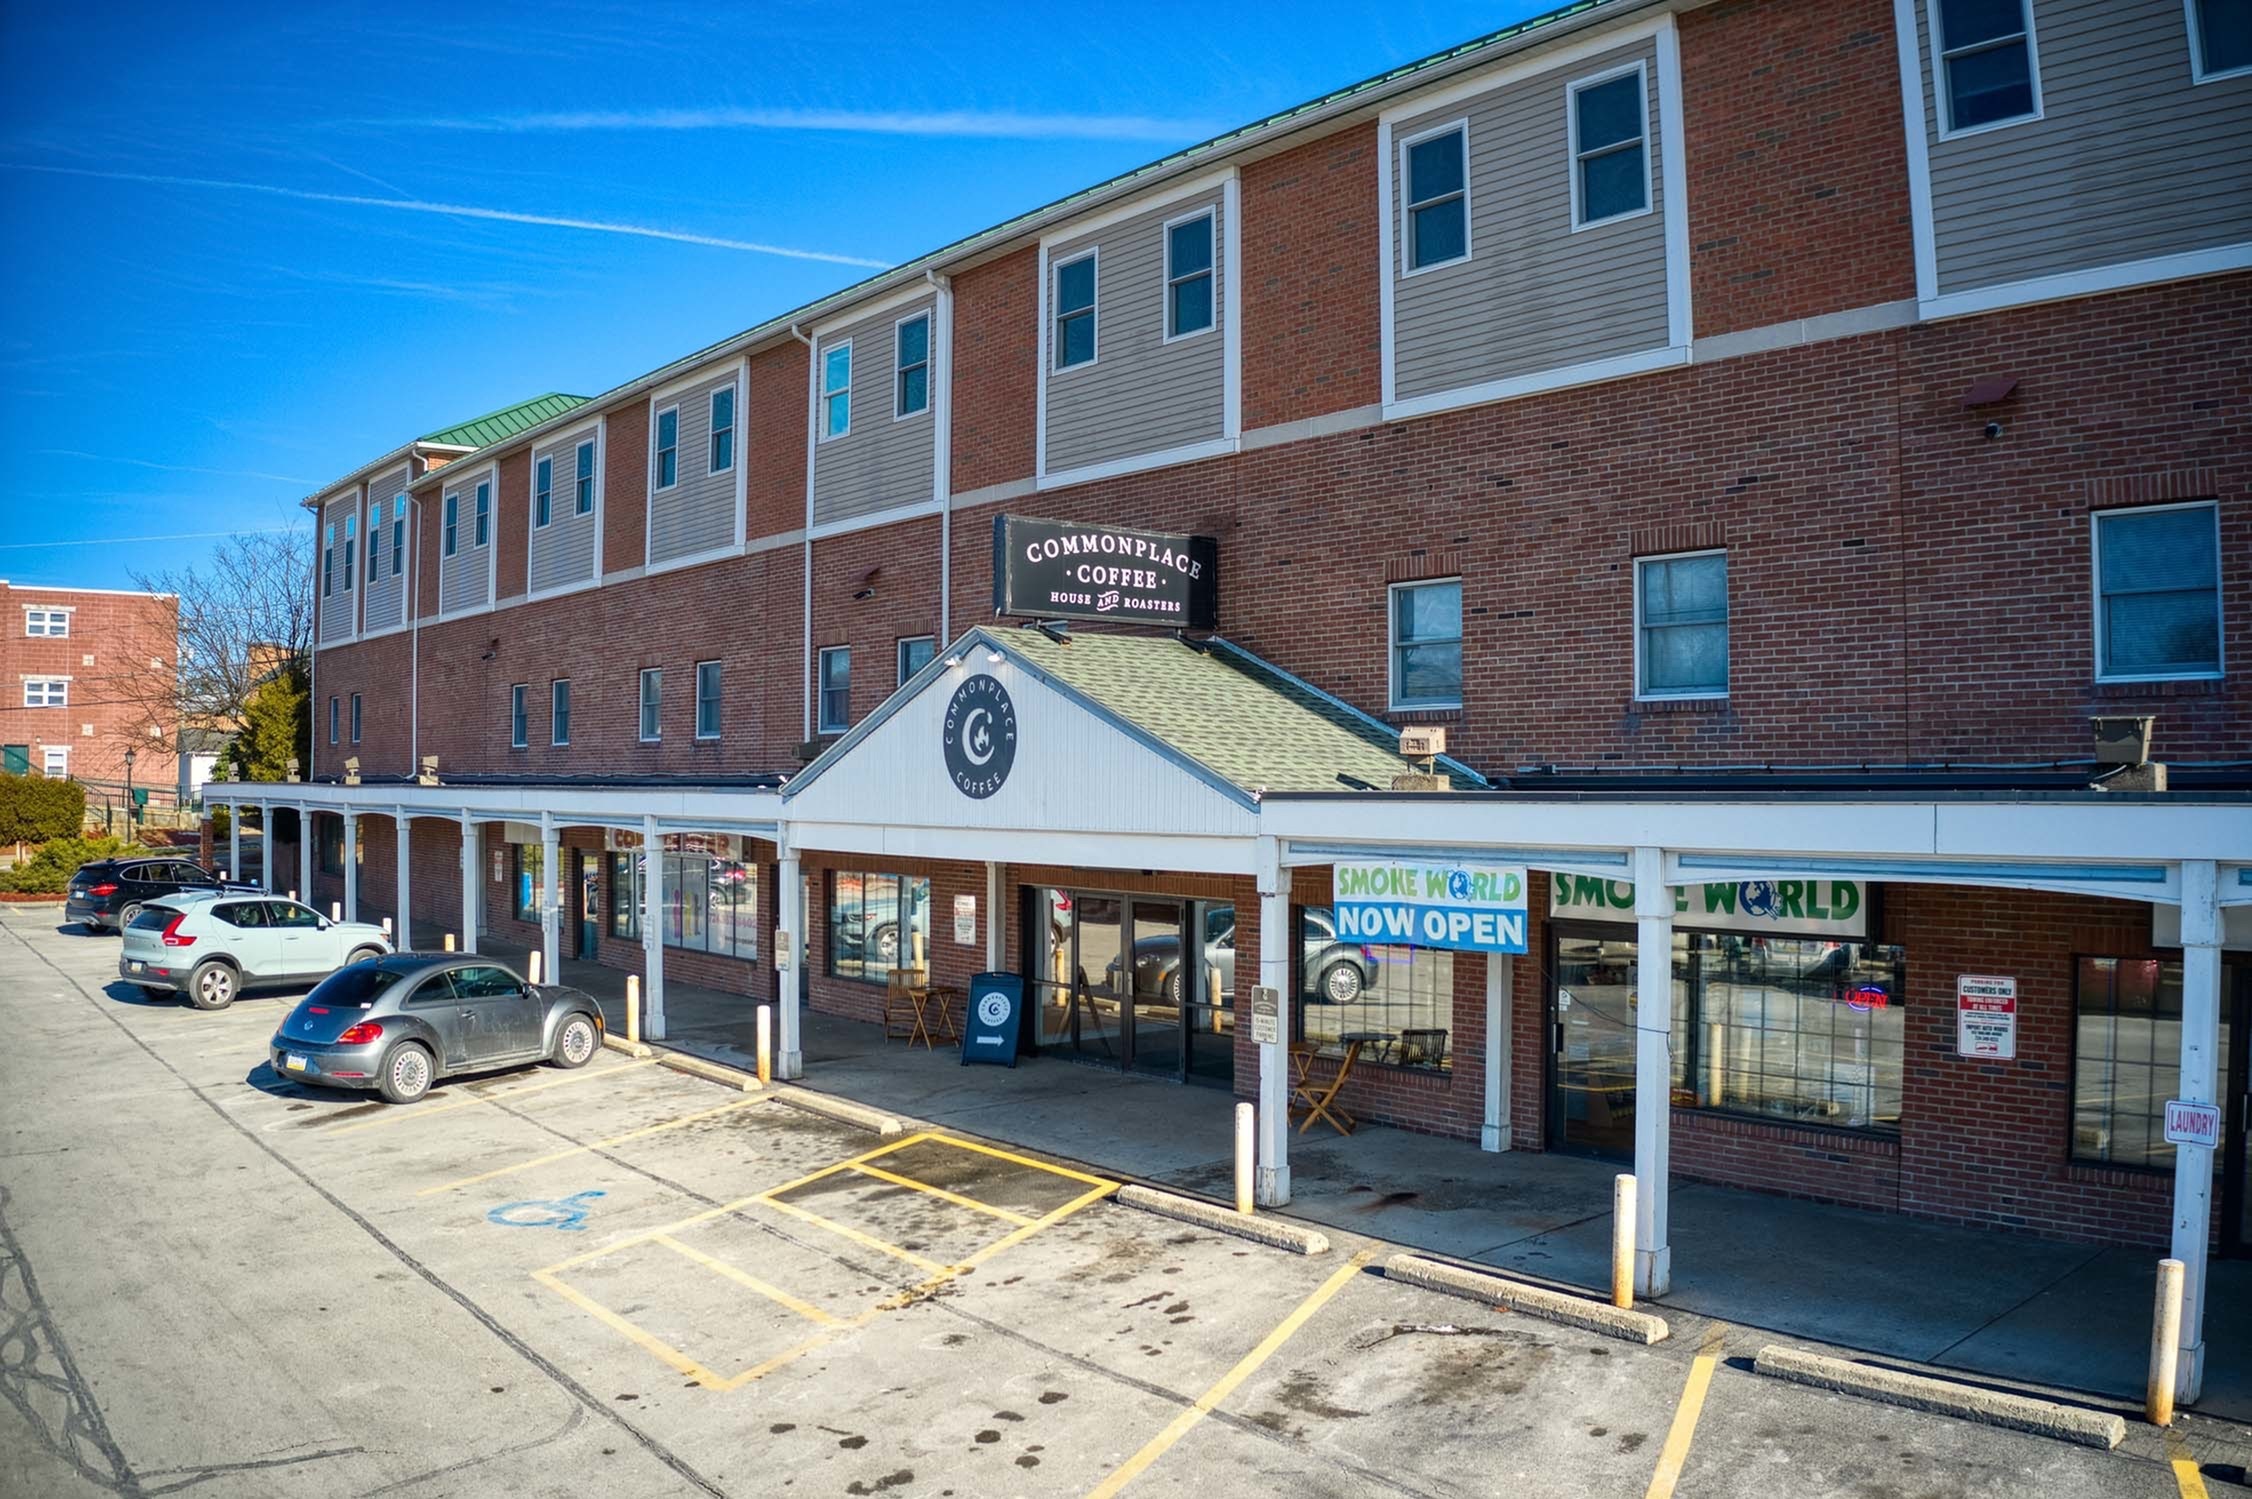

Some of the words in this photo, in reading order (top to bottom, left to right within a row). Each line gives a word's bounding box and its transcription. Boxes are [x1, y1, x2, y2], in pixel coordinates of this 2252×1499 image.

[1026, 534, 1202, 580] COMMONPLACE
[1076, 564, 1157, 590] COFFEE
[1050, 591, 1092, 606] HOUSE
[1096, 592, 1120, 610] AND
[1123, 597, 1182, 613] ROASTERS
[946, 679, 1015, 745] COMMONPLACE
[956, 771, 1002, 796] COFFEE
[1338, 867, 1418, 897] SMOKE
[1426, 868, 1522, 903] WORLD
[1555, 872, 1689, 912] SMOE
[1339, 906, 1416, 938] NOW
[1423, 910, 1523, 947] OPEN
[1845, 988, 1889, 1010] OPEN
[1963, 985, 1997, 995] CUSTOMERS
[1998, 987, 2012, 996] ONLY
[2170, 1109, 2215, 1136] LAUNDRY
